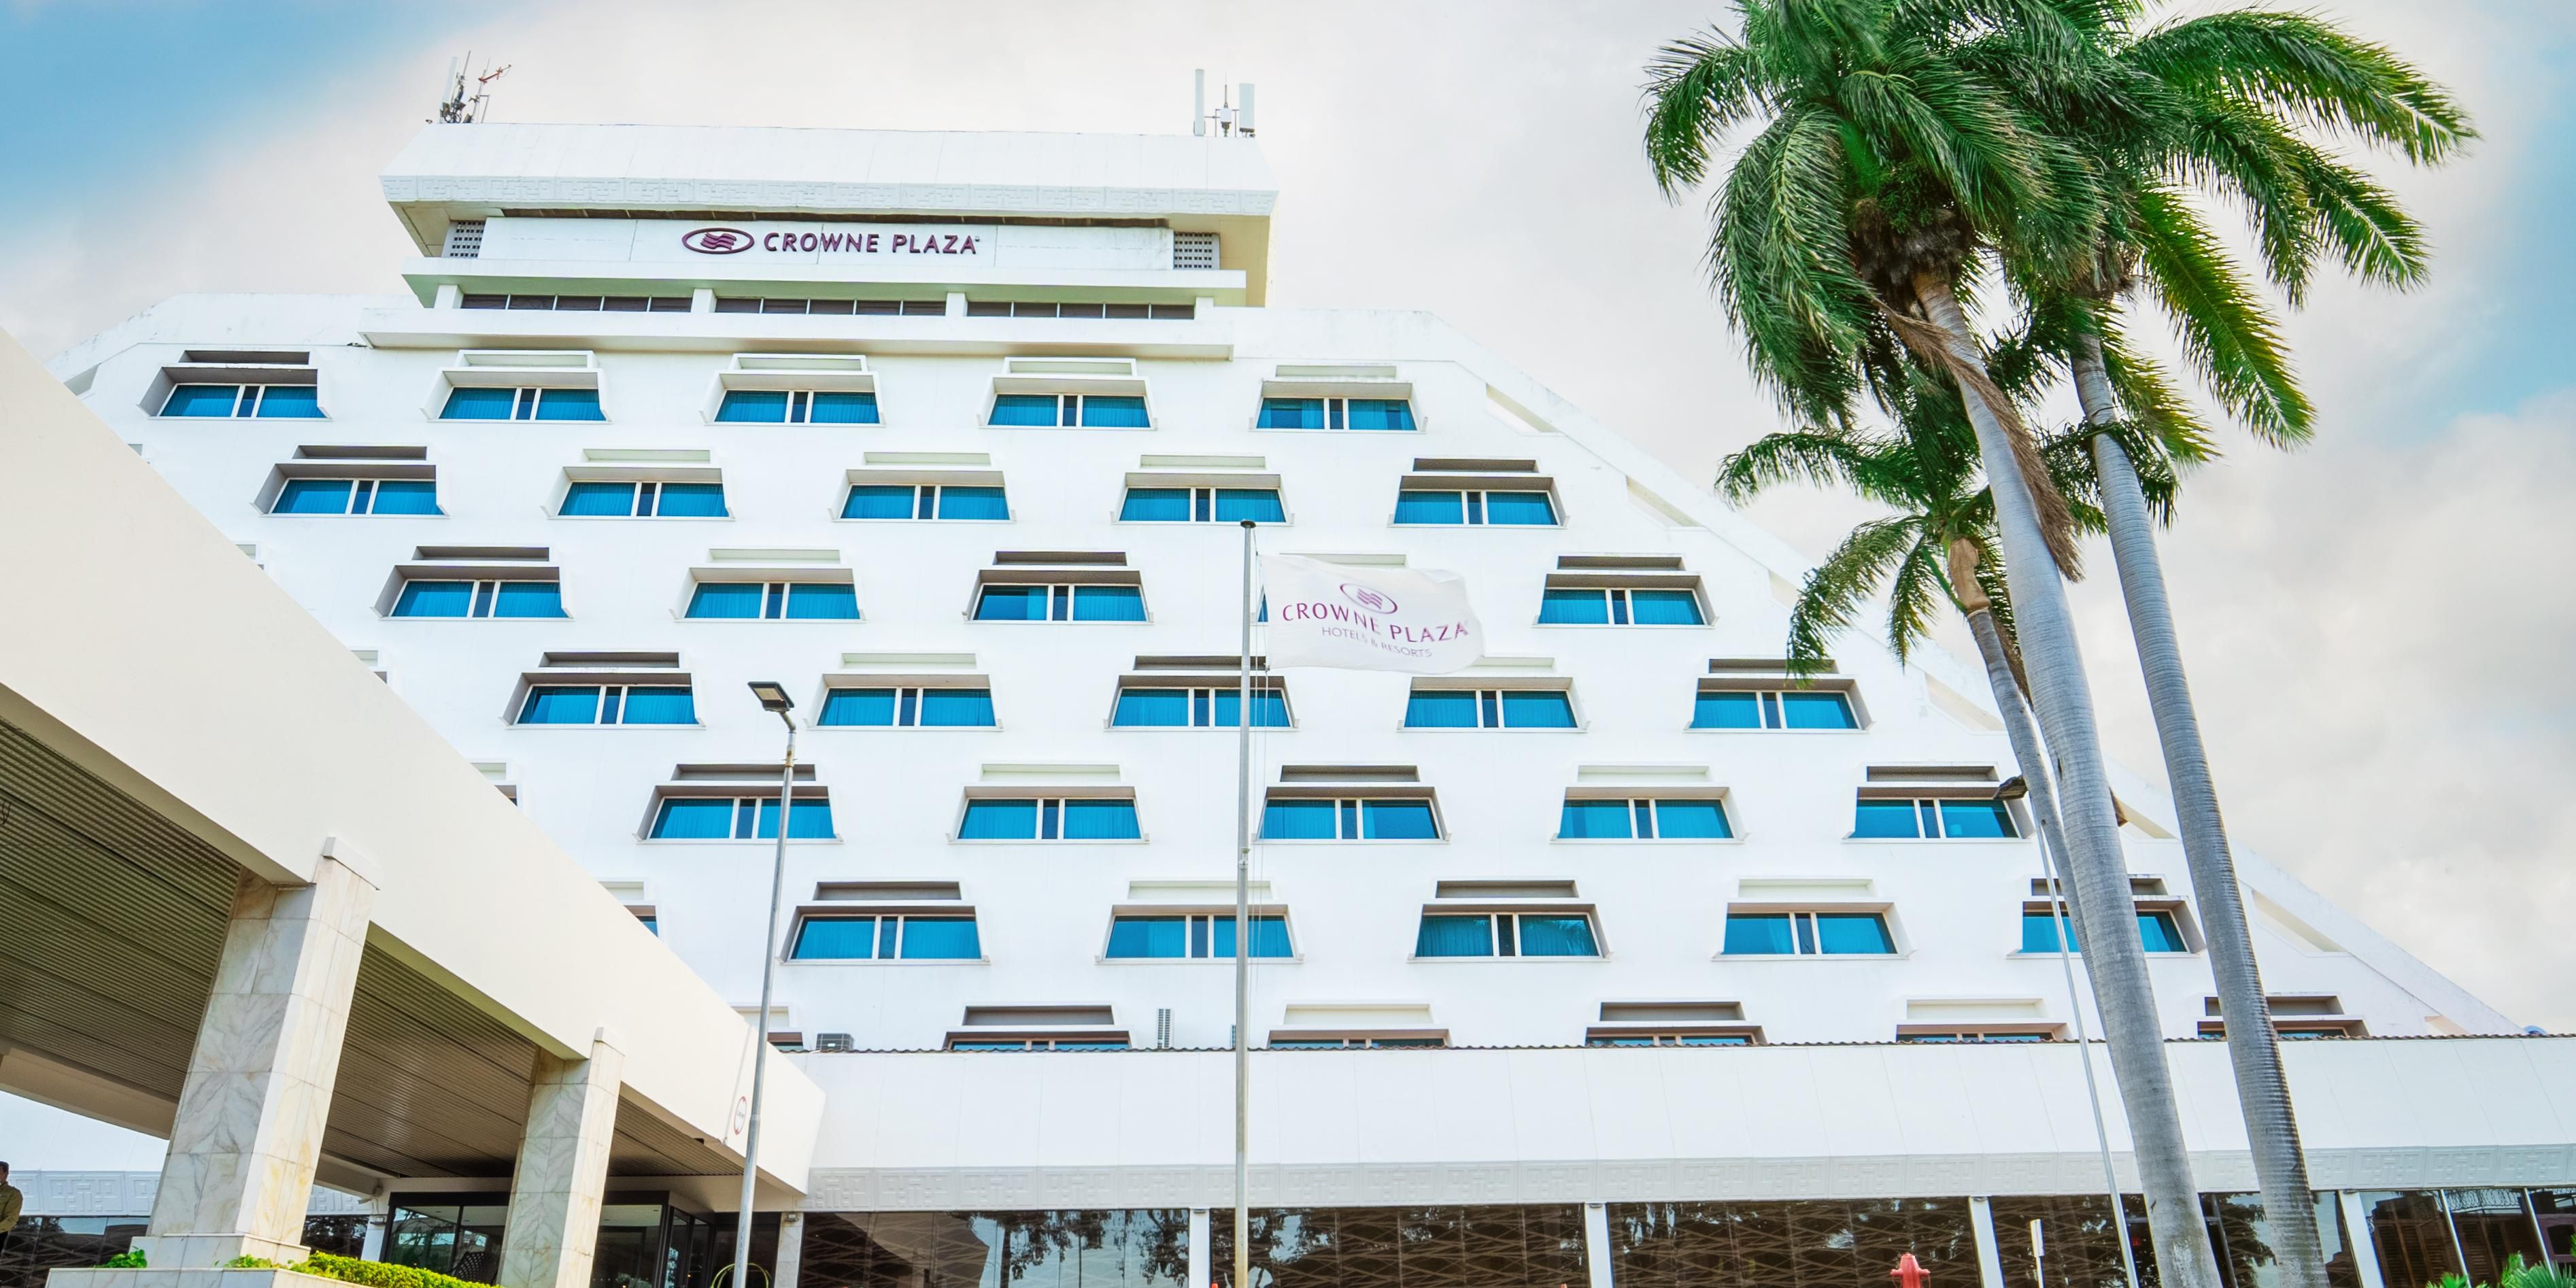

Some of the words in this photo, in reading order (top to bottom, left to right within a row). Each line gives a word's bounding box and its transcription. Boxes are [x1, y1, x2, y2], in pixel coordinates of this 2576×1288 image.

[763, 232, 879, 253] CROWNE
[892, 234, 977, 254] PLAZA
[1282, 602, 1381, 635] CROWNE
[1389, 621, 1470, 643] PLAZA
[1321, 626, 1368, 644] HOTELS
[1381, 641, 1433, 658] RESORTS
